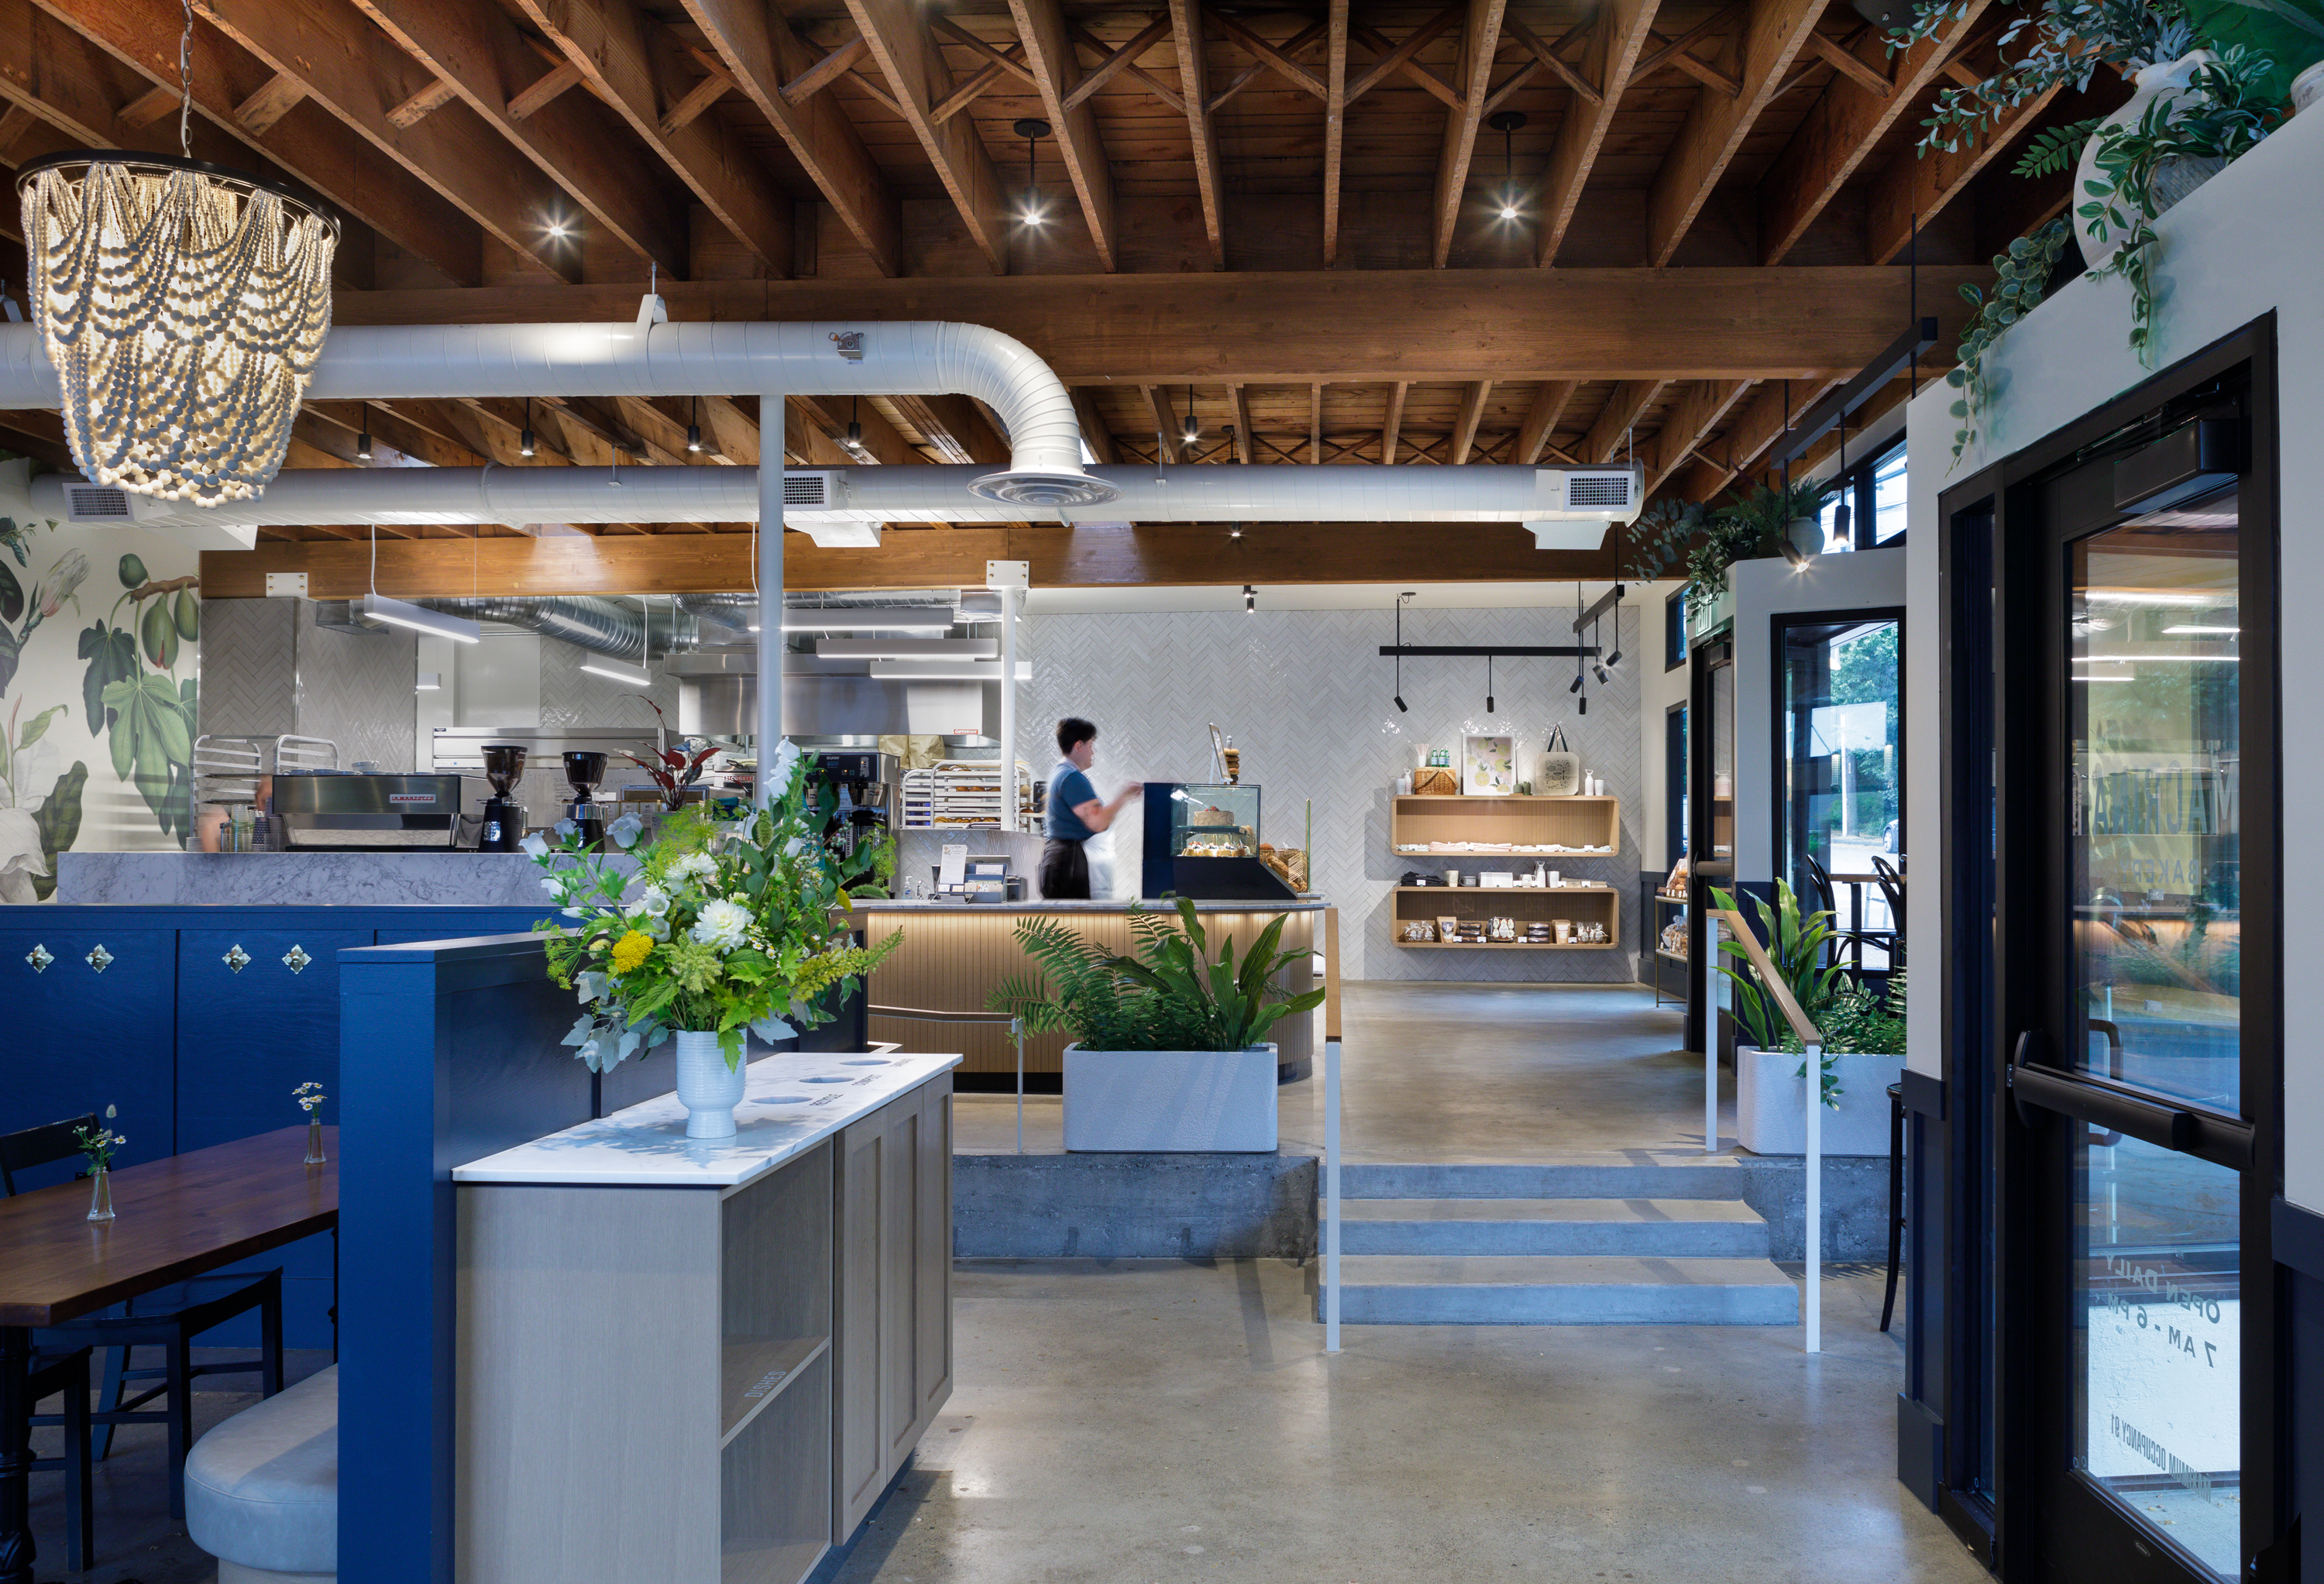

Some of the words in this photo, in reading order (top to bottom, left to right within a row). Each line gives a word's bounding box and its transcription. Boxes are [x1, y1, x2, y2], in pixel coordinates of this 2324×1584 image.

[1472, 744, 1510, 784] SUMMER
[809, 1094, 844, 1106] RECYCLE
[744, 1371, 786, 1397] DISHES
